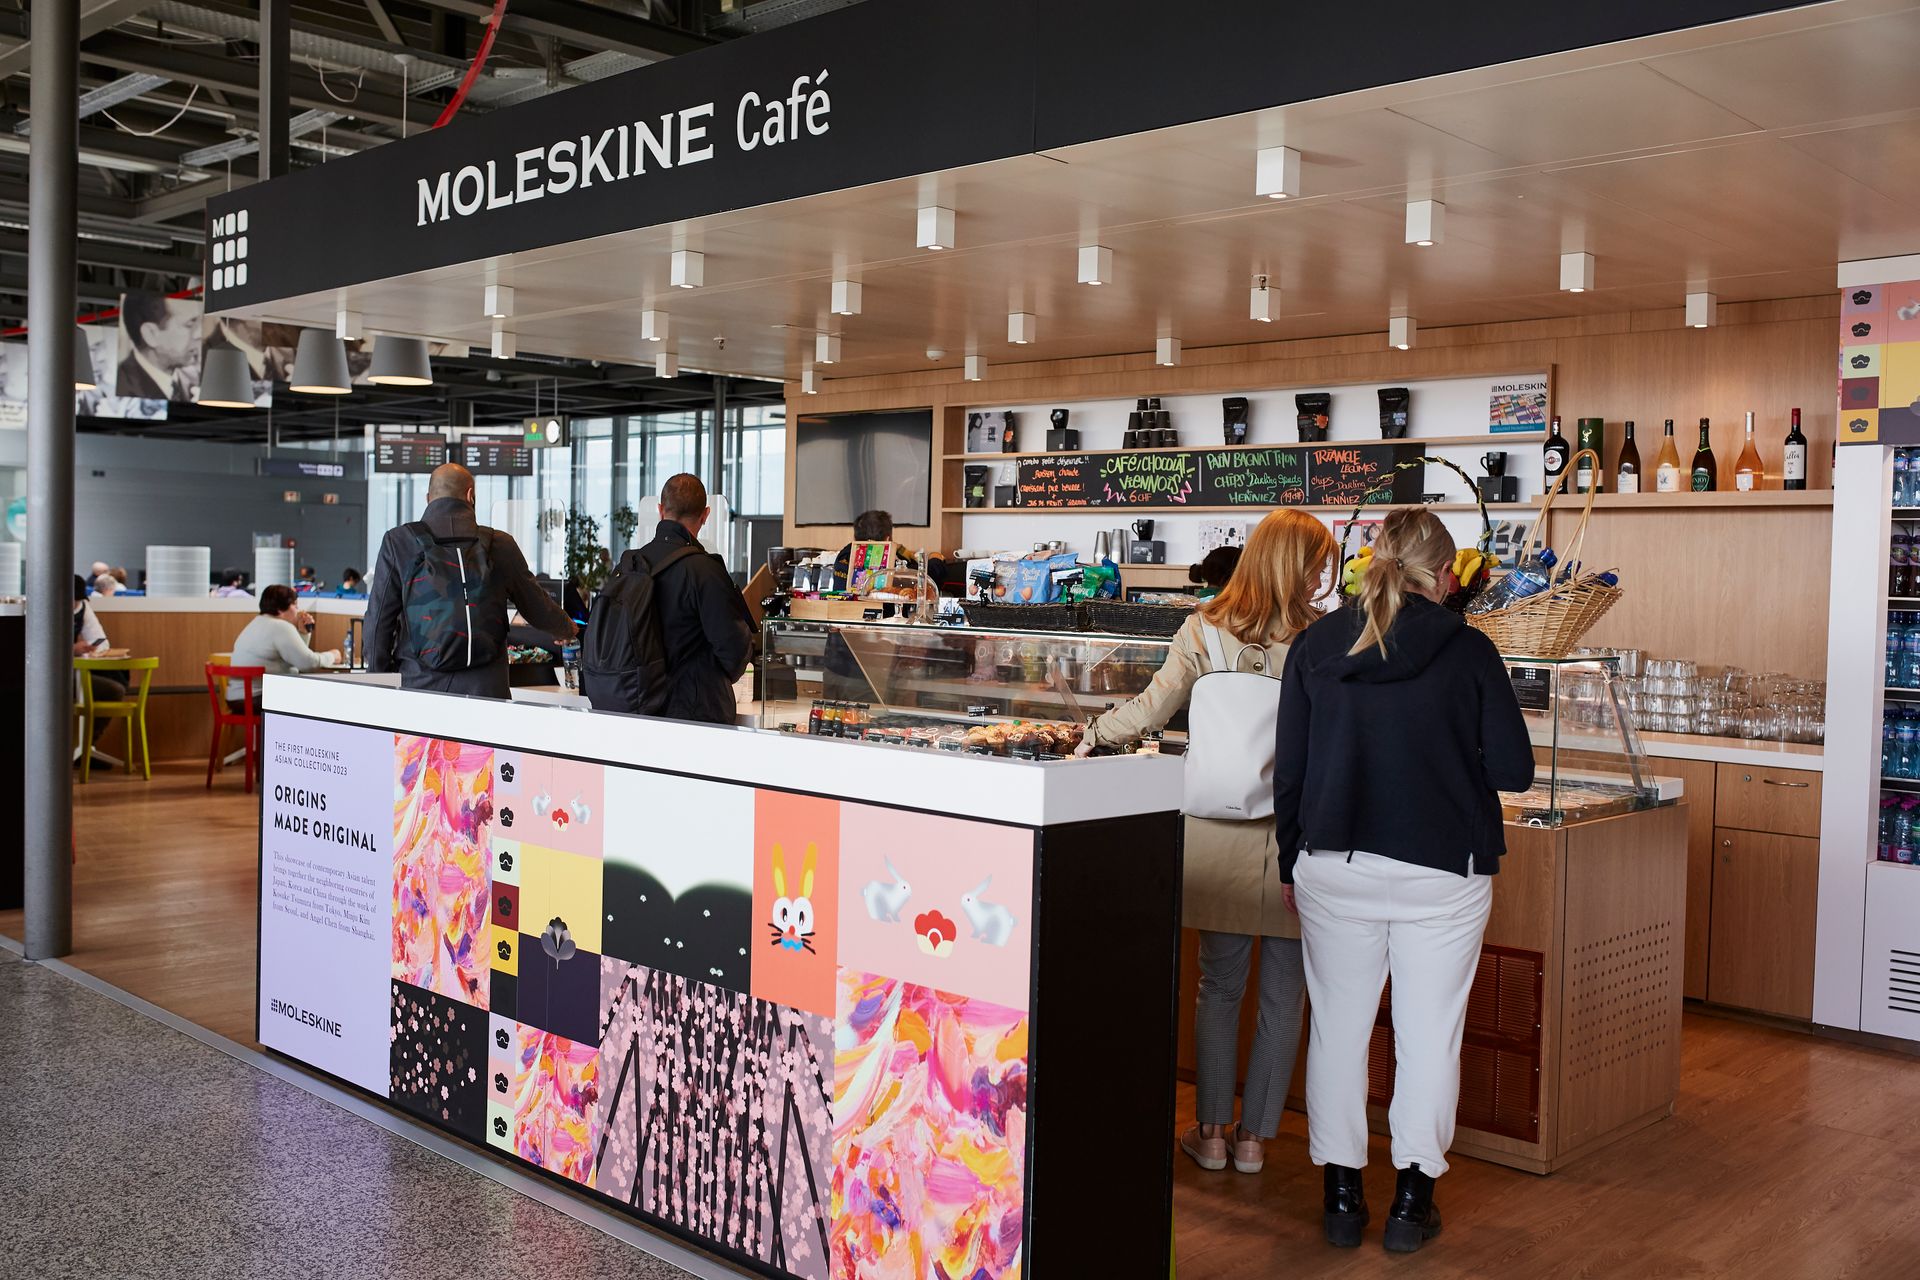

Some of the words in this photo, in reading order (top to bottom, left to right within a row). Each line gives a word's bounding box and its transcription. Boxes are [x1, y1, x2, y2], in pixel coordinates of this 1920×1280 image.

[417, 102, 714, 226] MOLESKINE
[736, 69, 831, 151] Café
[1129, 490, 1137, 502] 6
[1138, 493, 1152, 502] CHF
[1229, 491, 1277, 504] HENNIEZ
[1322, 494, 1360, 505] HENNIEZ
[275, 741, 286, 751] THE
[287, 743, 304, 754] FIRST
[305, 747, 340, 761] MOLESKINE
[275, 755, 293, 765] ASIAN
[293, 758, 332, 772] COLLECTION
[333, 765, 348, 776] 2023
[274, 784, 326, 811] ORIGINS
[274, 811, 308, 835] MADE
[313, 820, 377, 853] ORIGINAL
[284, 854, 305, 867] showcase
[312, 863, 345, 877] contemporary
[347, 871, 360, 882] Asian
[361, 875, 376, 887] talent
[288, 880, 302, 891] Korea
[303, 885, 312, 895] and
[347, 898, 356, 908] the
[307, 873, 315, 882] the
[345, 886, 368, 898] countries
[300, 911, 309, 920] and
[338, 921, 350, 933] from
[278, 1001, 342, 1038] MOLESKINE
